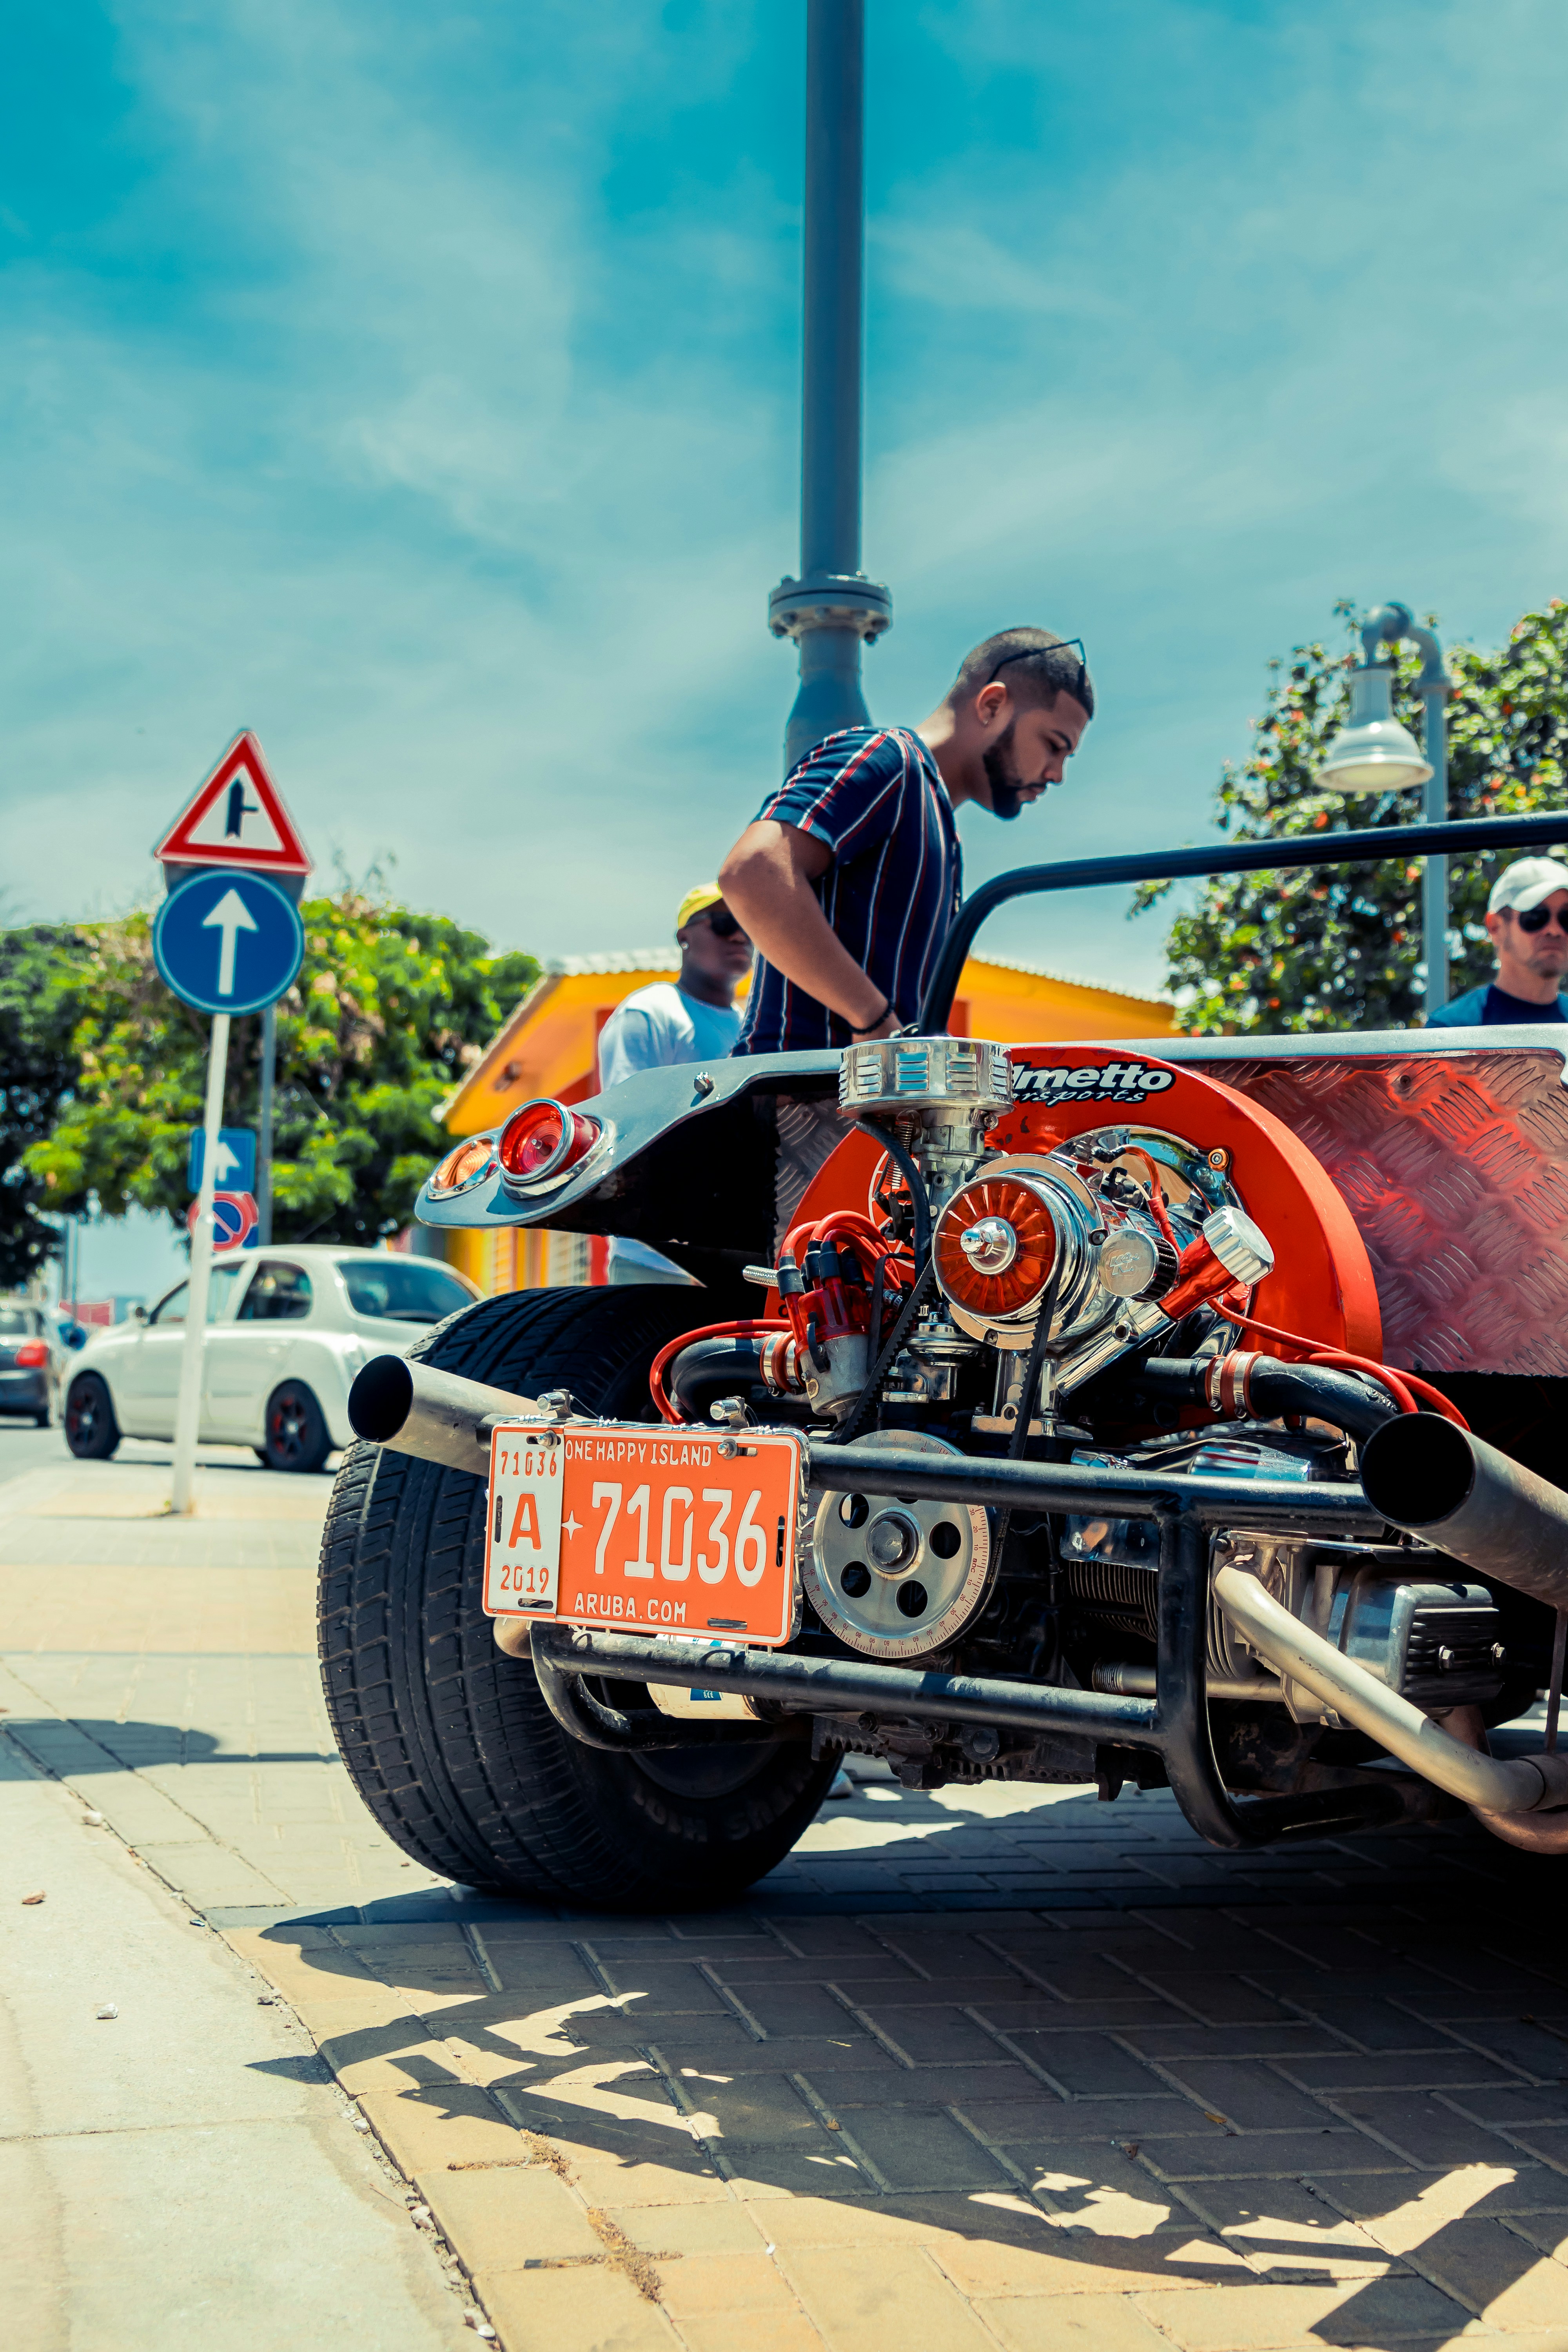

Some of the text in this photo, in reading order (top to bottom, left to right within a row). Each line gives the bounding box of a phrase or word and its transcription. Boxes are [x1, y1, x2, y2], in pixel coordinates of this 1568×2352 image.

[501, 1451, 557, 1477] 71036
[565, 1439, 712, 1467] ONE HAPPY ISLAND
[508, 1493, 542, 1550] A
[592, 1481, 767, 1587] 71036
[500, 1564, 549, 1594] 2019
[574, 1592, 686, 1623] ARUBA.COM
